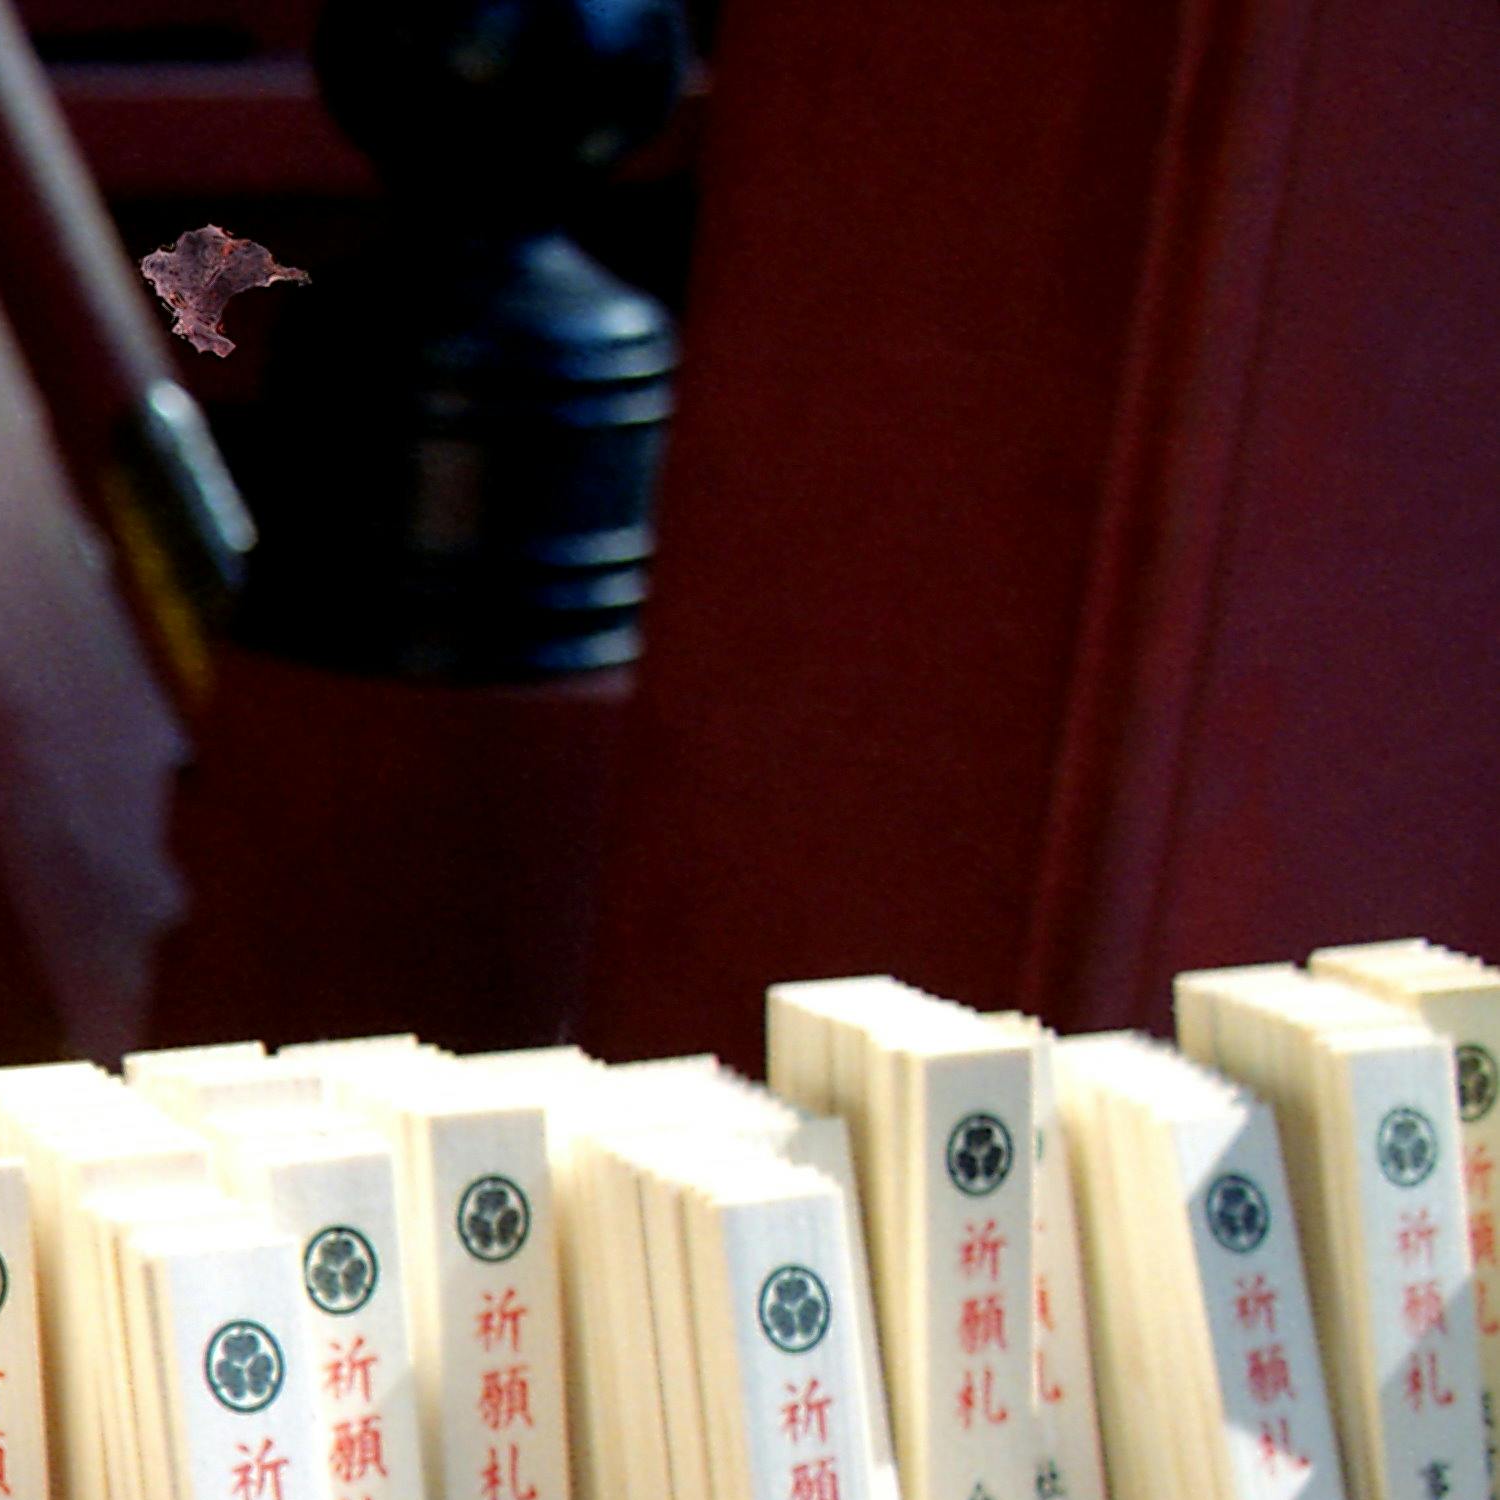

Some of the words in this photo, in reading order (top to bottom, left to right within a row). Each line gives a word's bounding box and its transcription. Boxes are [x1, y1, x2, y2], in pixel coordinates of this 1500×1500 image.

[957, 1218, 1009, 1430] 祈願札
[1234, 1271, 1313, 1475] 祈願札
[1397, 1208, 1454, 1410] 祈願札
